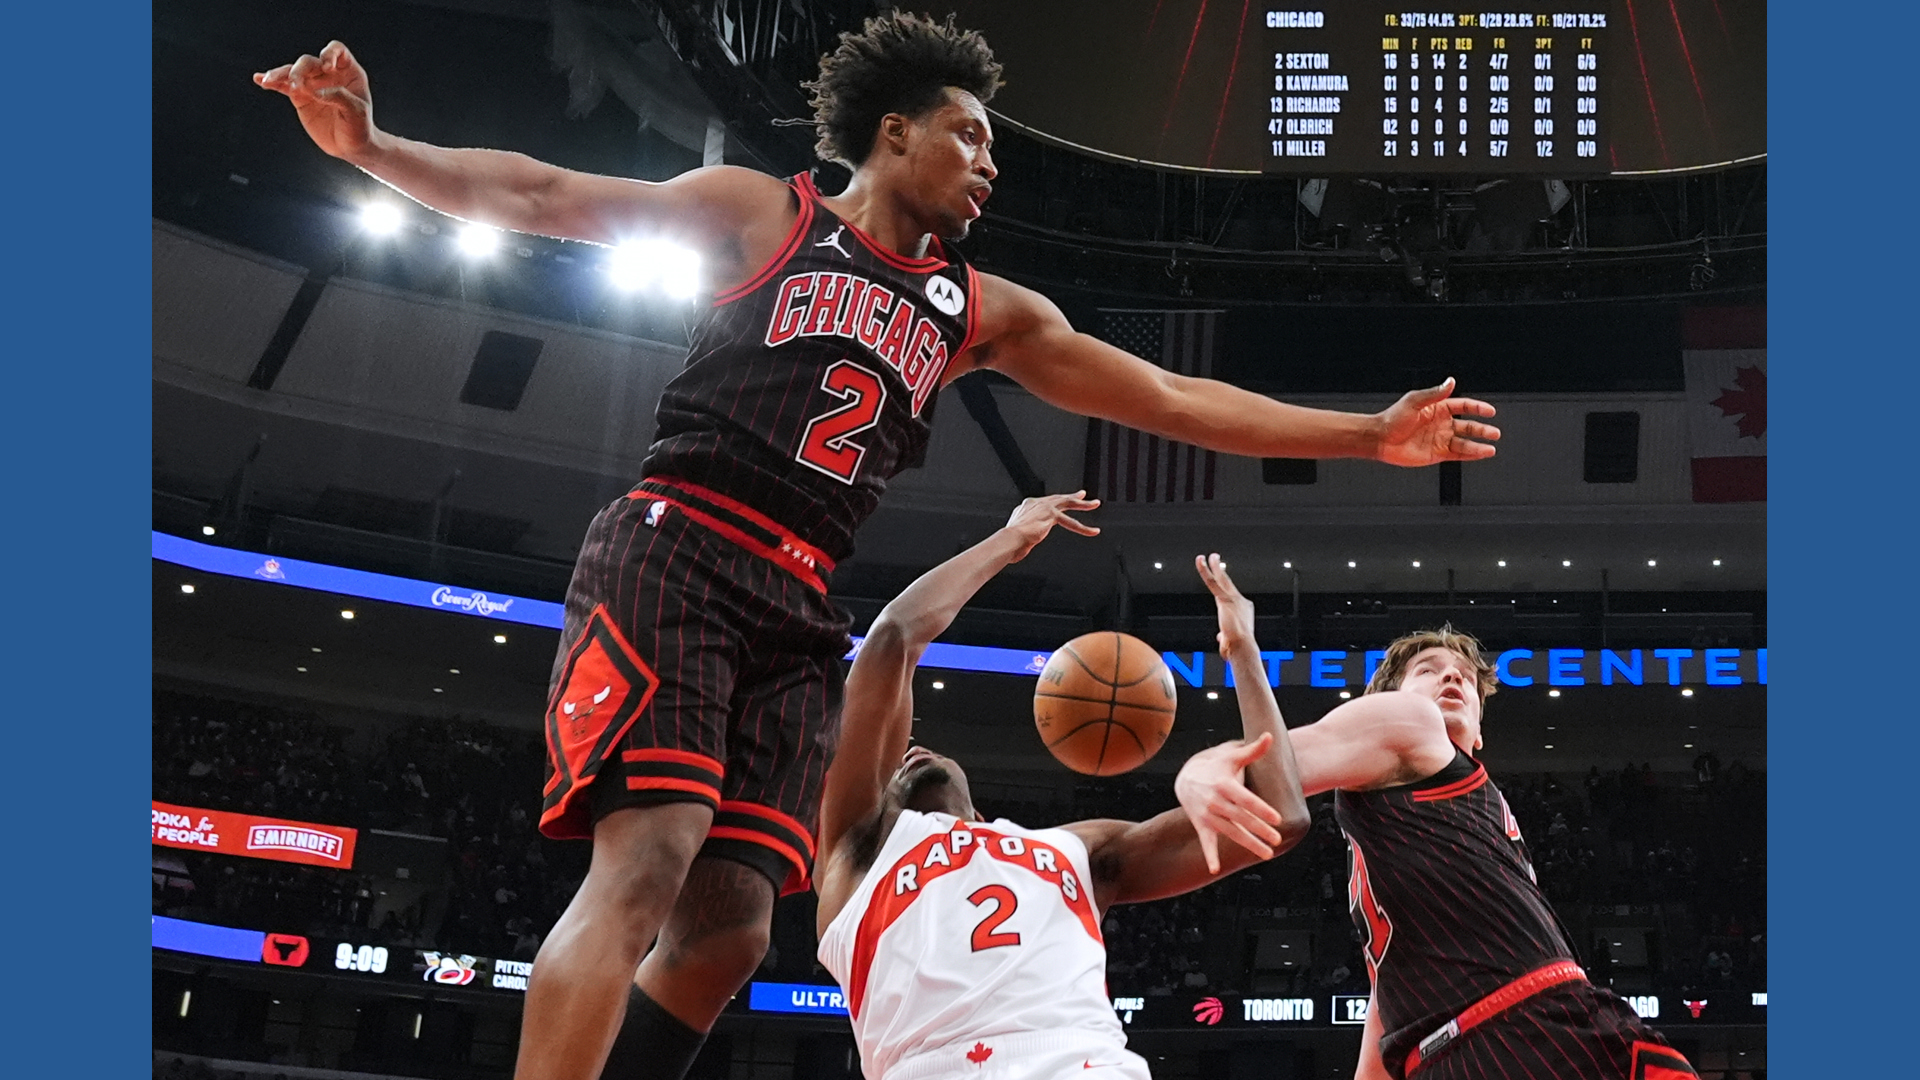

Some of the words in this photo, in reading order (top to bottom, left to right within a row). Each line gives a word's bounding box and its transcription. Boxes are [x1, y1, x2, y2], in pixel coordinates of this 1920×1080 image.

[1266, 12, 1325, 28] CHICAGO
[1384, 14, 1399, 27] FG:
[1401, 12, 1427, 28] 33/75
[1427, 13, 1456, 28] 44.0%
[1458, 14, 1478, 27] 3PT:
[1479, 12, 1503, 29] 8/28
[1503, 13, 1534, 28] 28.6%
[1536, 14, 1550, 27] FT:
[1552, 12, 1577, 29] 16/21
[1577, 13, 1607, 28] 76.2%
[1382, 37, 1399, 50] MIN
[1412, 37, 1418, 50] F
[1430, 37, 1448, 51] PTS
[1455, 37, 1473, 51] REB
[1493, 37, 1506, 49] FG
[1535, 37, 1552, 49] 3PT
[1581, 37, 1593, 49] FT
[1274, 53, 1283, 70] 2
[1285, 53, 1330, 70] SEXTON
[1384, 53, 1398, 70] 16
[1411, 53, 1419, 70] 5
[1432, 53, 1446, 70] 14
[1459, 53, 1468, 70] 2
[1489, 53, 1509, 71] 4/7
[1535, 53, 1551, 71] 0/1
[1577, 53, 1597, 71] 6/8
[1275, 75, 1283, 92] 8
[1286, 75, 1349, 92] KAWAMURA
[1383, 75, 1397, 92] 01
[1411, 75, 1419, 92] 0
[1434, 75, 1444, 92] 0
[1459, 75, 1468, 92] 0
[1489, 75, 1510, 93] 0/0
[1534, 75, 1554, 93] 0/0
[1577, 75, 1597, 93] 0/0
[1270, 97, 1284, 114] 13
[1285, 97, 1341, 114] RICHARDS
[1384, 97, 1398, 114] 15
[1411, 97, 1419, 114] 0
[1434, 97, 1443, 114] 4
[1459, 97, 1468, 114] 6
[1489, 97, 1509, 115] 2/5
[1534, 97, 1551, 115] 0/1
[1577, 97, 1597, 115] 0/0
[1268, 118, 1284, 135] 47
[1285, 118, 1334, 135] OLBRICH
[1383, 118, 1399, 135] 02
[1411, 118, 1419, 135] 0
[1434, 118, 1444, 135] 0
[1459, 118, 1468, 135] 0
[1489, 118, 1510, 136] 0/0
[1534, 118, 1554, 136] 0/0
[1577, 118, 1597, 136] 0/0
[1271, 140, 1283, 157] 11
[1286, 140, 1326, 157] MILLER
[1383, 140, 1398, 157] 21
[1411, 140, 1419, 157] 3
[1433, 140, 1445, 157] 11
[1458, 140, 1467, 157] 4
[1489, 140, 1509, 158] 5/7
[1536, 140, 1553, 158] 1/2
[1577, 140, 1597, 158] 0/0
[764, 271, 948, 418] CHICAGO
[795, 359, 888, 485] 2
[431, 586, 472, 606] Crown
[462, 592, 514, 616] Royal
[195, 816, 214, 832] for
[157, 826, 219, 847] PEOPLE
[254, 830, 337, 854] SMIRNOFF
[966, 884, 1021, 953] 2
[335, 942, 389, 974] 9:09
[1113, 997, 1145, 1010] FOULS
[1242, 998, 1314, 1021] TORONTO
[1124, 1010, 1133, 1024] 4
